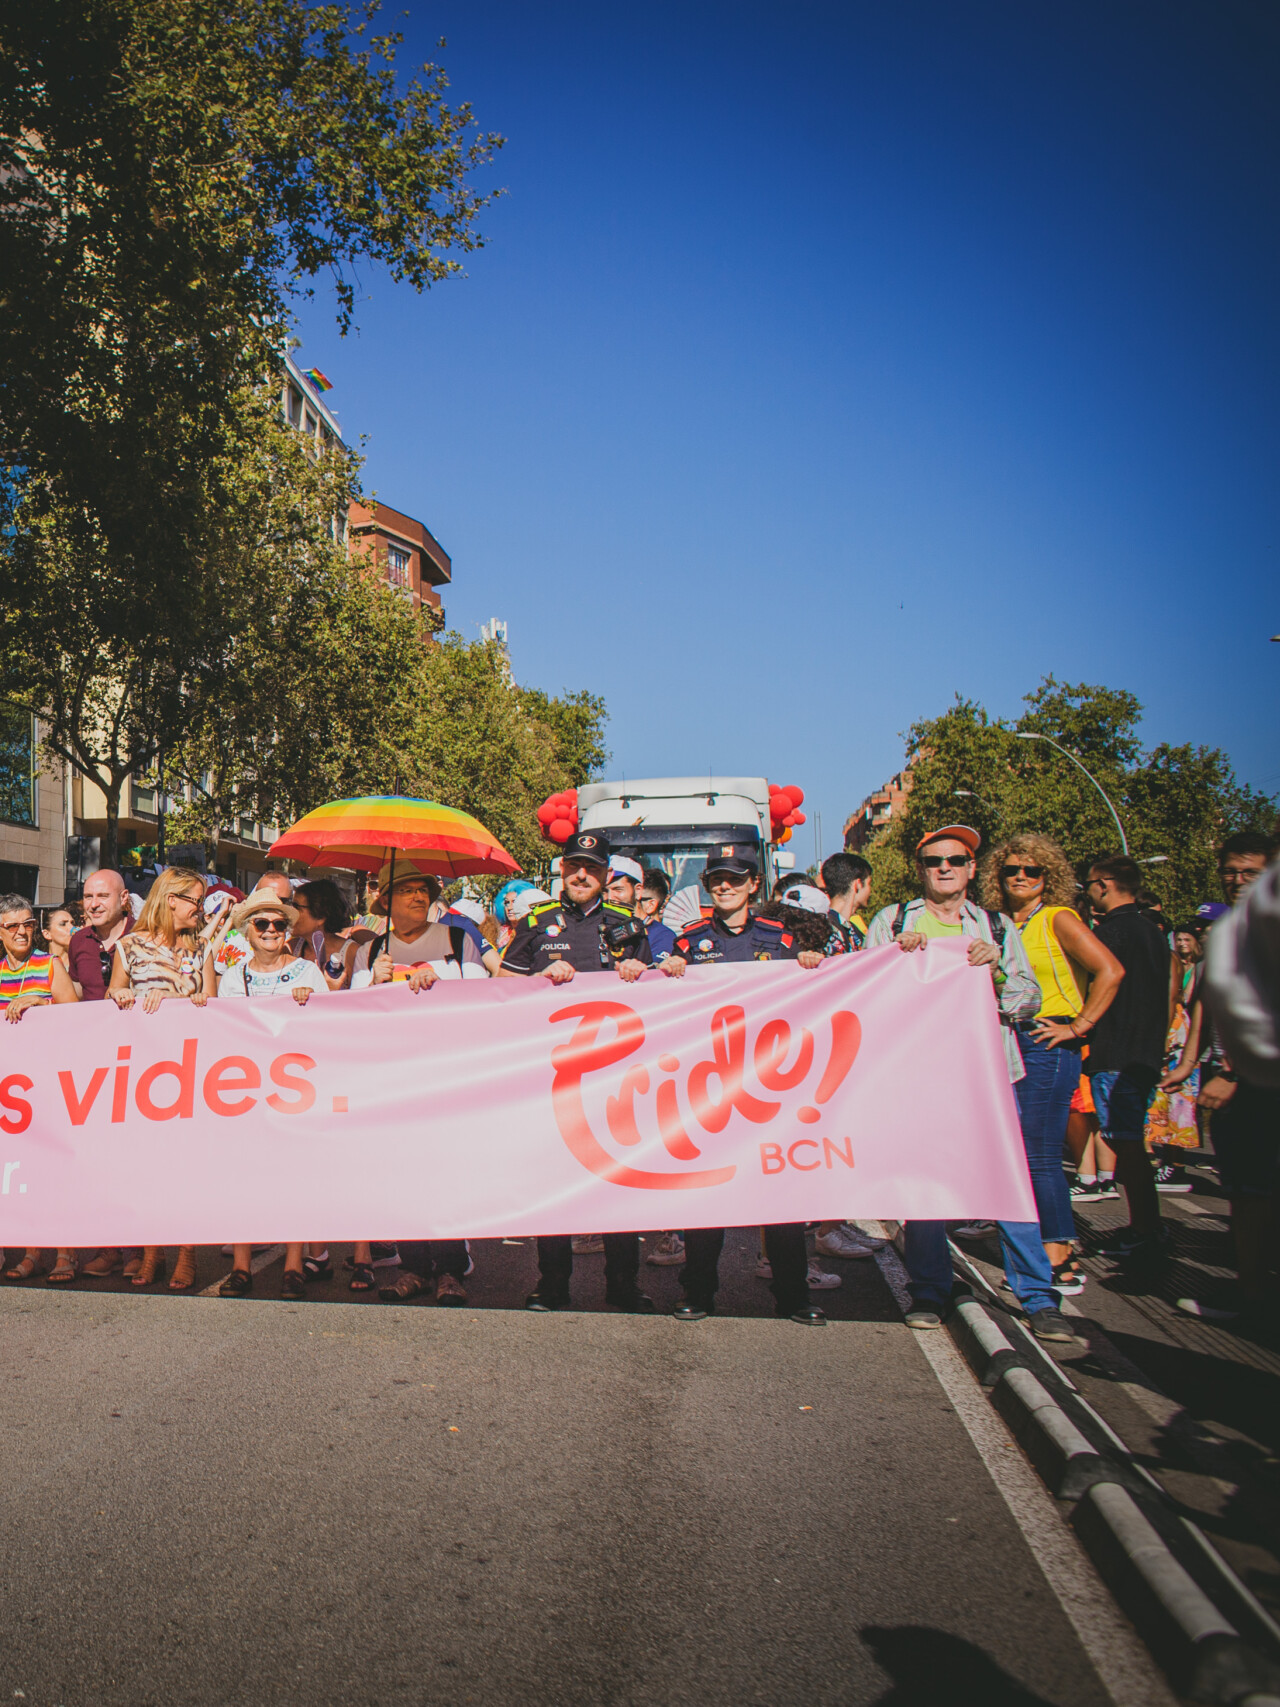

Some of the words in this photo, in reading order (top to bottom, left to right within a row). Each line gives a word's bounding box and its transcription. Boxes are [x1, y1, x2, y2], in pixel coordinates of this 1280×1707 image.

[540, 943, 571, 951] POLICIA
[548, 1000, 862, 1190] Pride!
[760, 1136, 855, 1175] BCN
